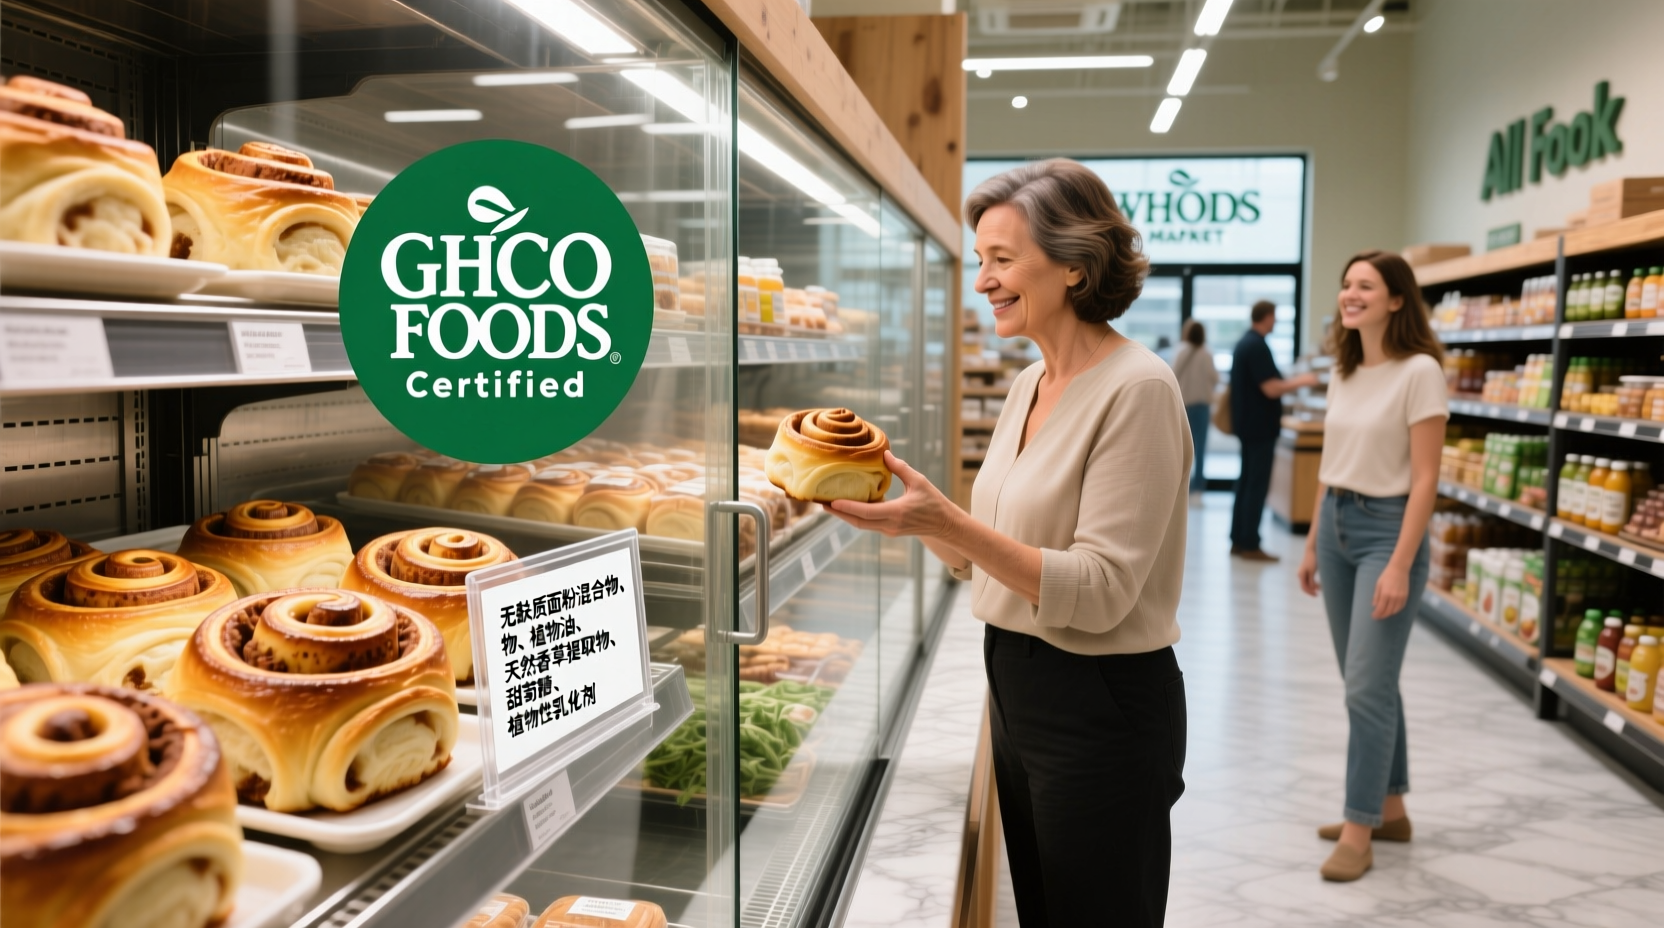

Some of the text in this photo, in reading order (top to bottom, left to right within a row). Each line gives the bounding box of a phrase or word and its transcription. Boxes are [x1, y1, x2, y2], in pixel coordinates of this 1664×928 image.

[1480, 79, 1627, 202] All Fook
[380, 231, 612, 299] GHCO
[1148, 229, 1225, 244] MARKET
[389, 302, 612, 361] FOODS
[405, 369, 585, 399] Certified
